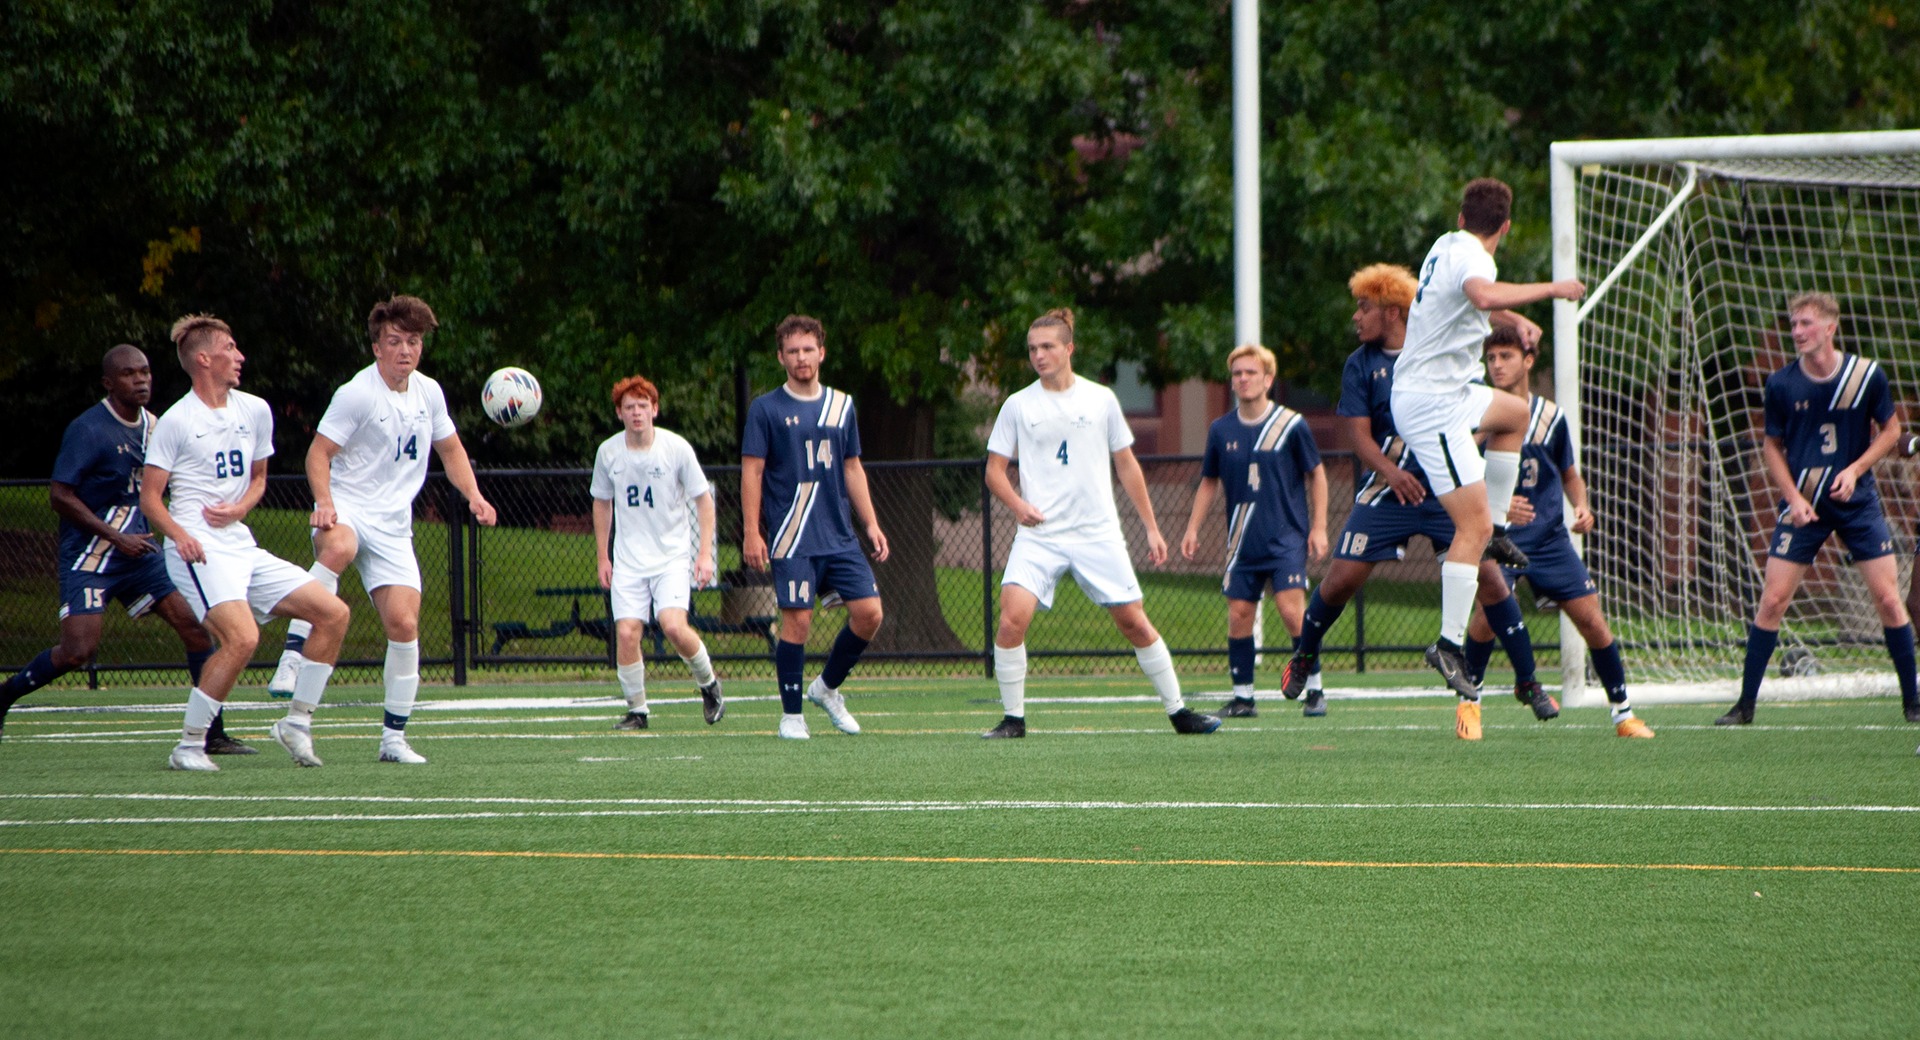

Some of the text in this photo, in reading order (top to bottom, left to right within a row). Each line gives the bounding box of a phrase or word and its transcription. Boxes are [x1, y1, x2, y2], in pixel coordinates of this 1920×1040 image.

[395, 434, 418, 462] 14
[1819, 423, 1838, 455] 3
[216, 449, 245, 479] 29
[805, 439, 833, 470] 14
[1056, 440, 1068, 465] 4
[1247, 462, 1260, 491] 4
[1515, 457, 1539, 488] 3
[626, 485, 654, 508] 24
[1341, 531, 1368, 556] 18
[1776, 532, 1793, 555] 3
[84, 587, 106, 609] 15
[789, 580, 810, 603] 14
